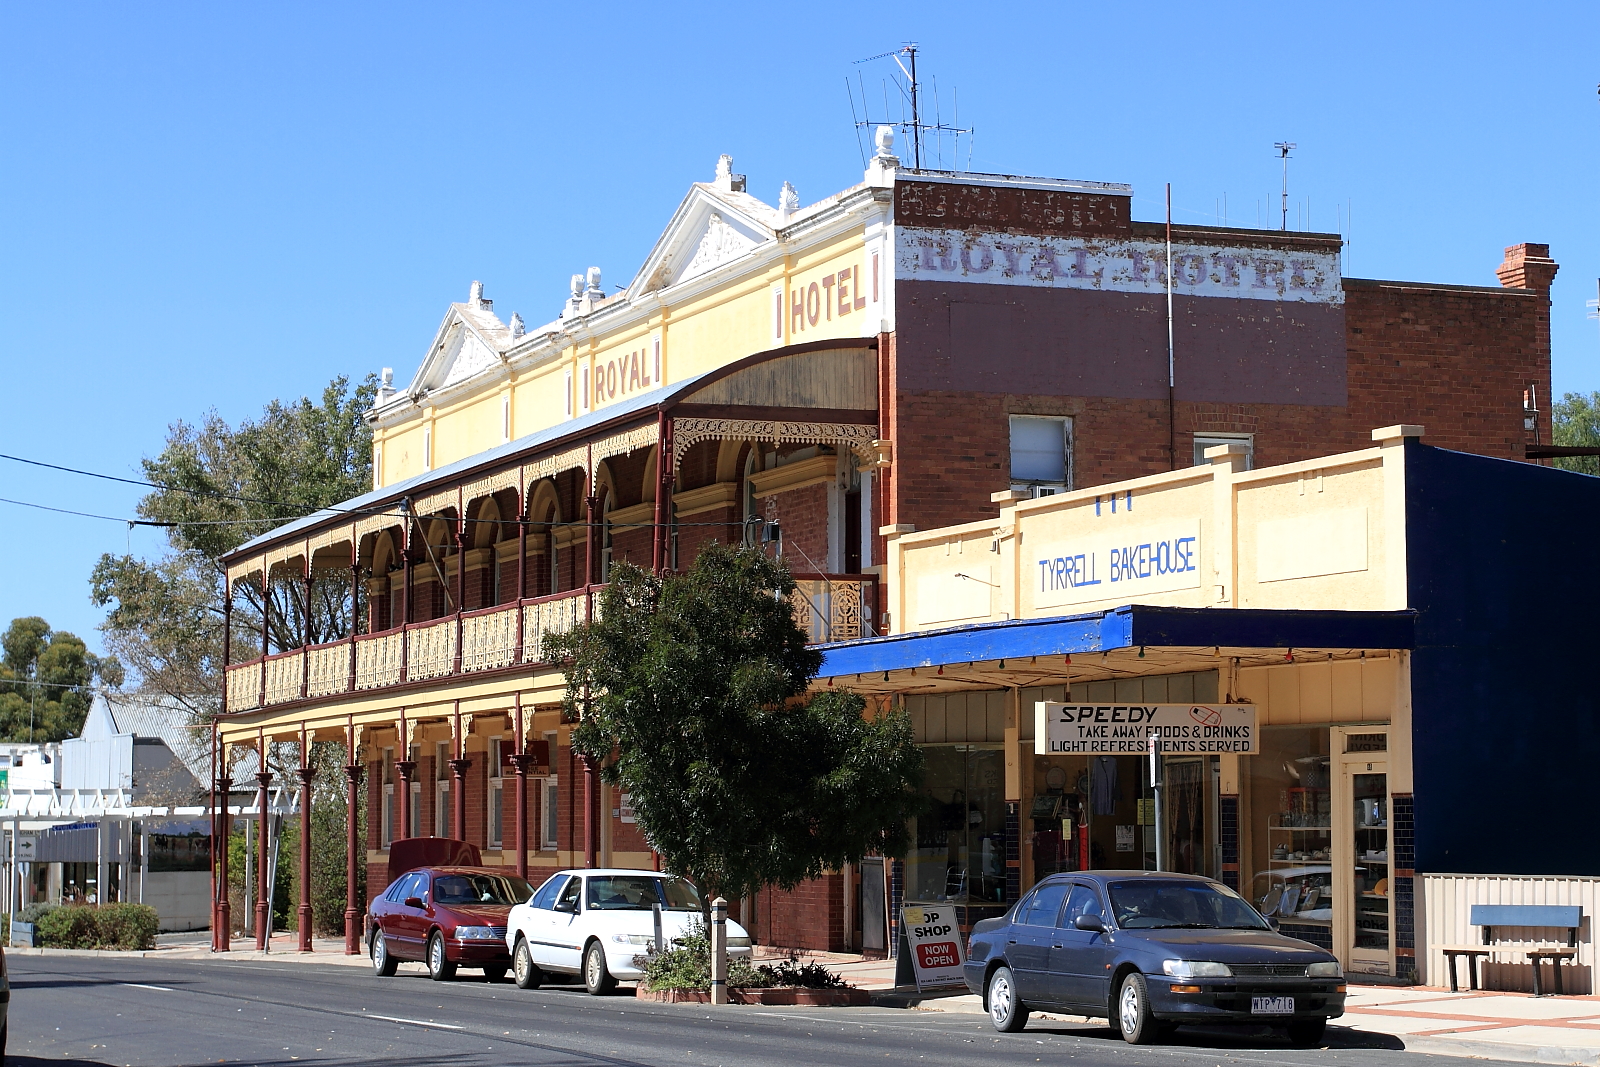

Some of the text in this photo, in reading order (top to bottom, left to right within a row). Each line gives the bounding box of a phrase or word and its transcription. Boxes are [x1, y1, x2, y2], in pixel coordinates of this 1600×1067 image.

[917, 237, 1323, 291] ROYAL HOTEL
[595, 264, 866, 404] ROYAL HOTEL
[1039, 537, 1196, 592] TYRRELL BAKEHOUSE
[1060, 707, 1158, 723] SPEEDY
[1078, 726, 1250, 739] TAKE AWAY FOODS & DRINKS
[1052, 740, 1250, 752] LIGHT REFRESHENTS SERVED
[915, 925, 951, 938] SHOP
[925, 945, 949, 955] NOW
[925, 955, 954, 966] OPEN
